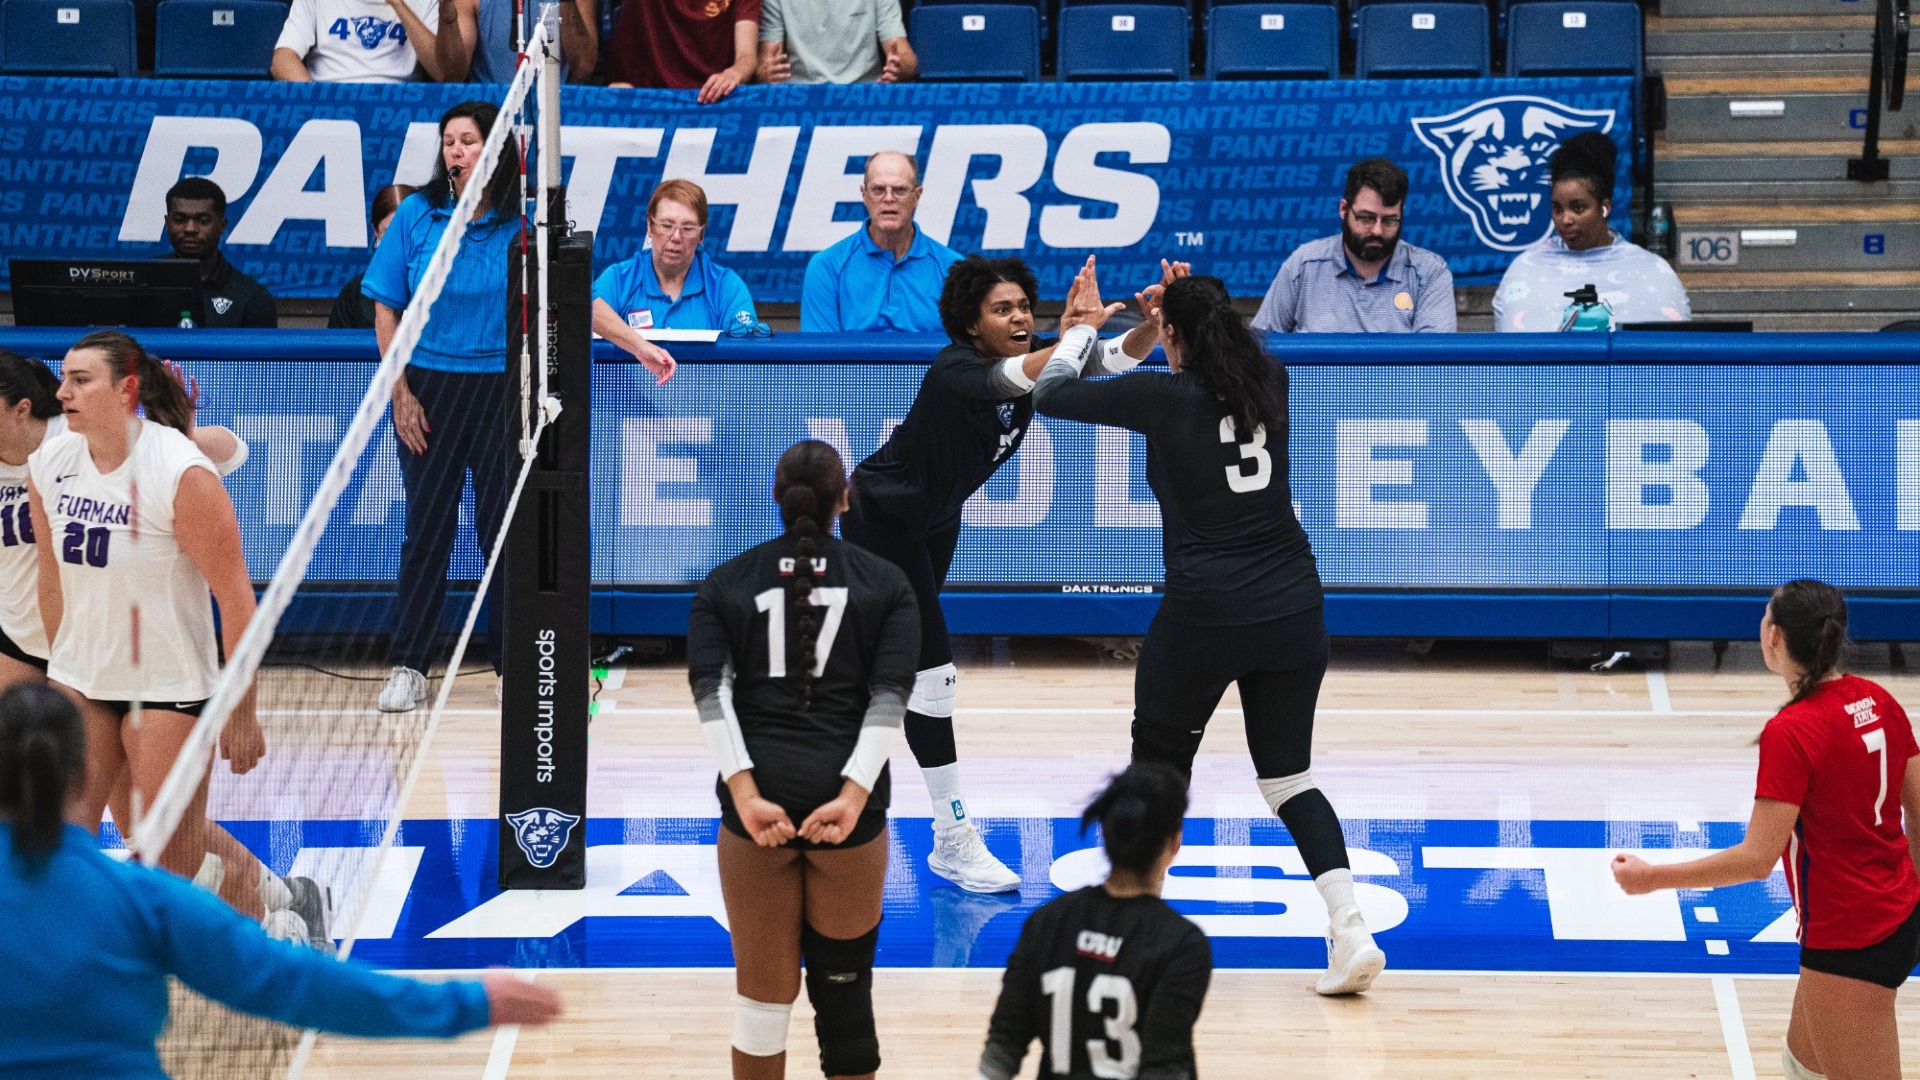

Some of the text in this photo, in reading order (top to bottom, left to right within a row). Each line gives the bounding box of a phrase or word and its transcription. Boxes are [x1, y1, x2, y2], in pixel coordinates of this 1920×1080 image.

[1208, 132, 1390, 159] PANTHERS
[1174, 232, 1204, 247] TM
[1687, 236, 1732, 261] 106
[1863, 234, 1885, 255] B
[1219, 414, 1272, 493] 3
[58, 494, 131, 526] FURMAN
[62, 521, 111, 568] 20
[778, 557, 828, 573] GU
[754, 586, 849, 678] 17
[533, 629, 557, 783] sports imports
[1861, 727, 1888, 827] 7
[1041, 965, 1142, 1080] 13
